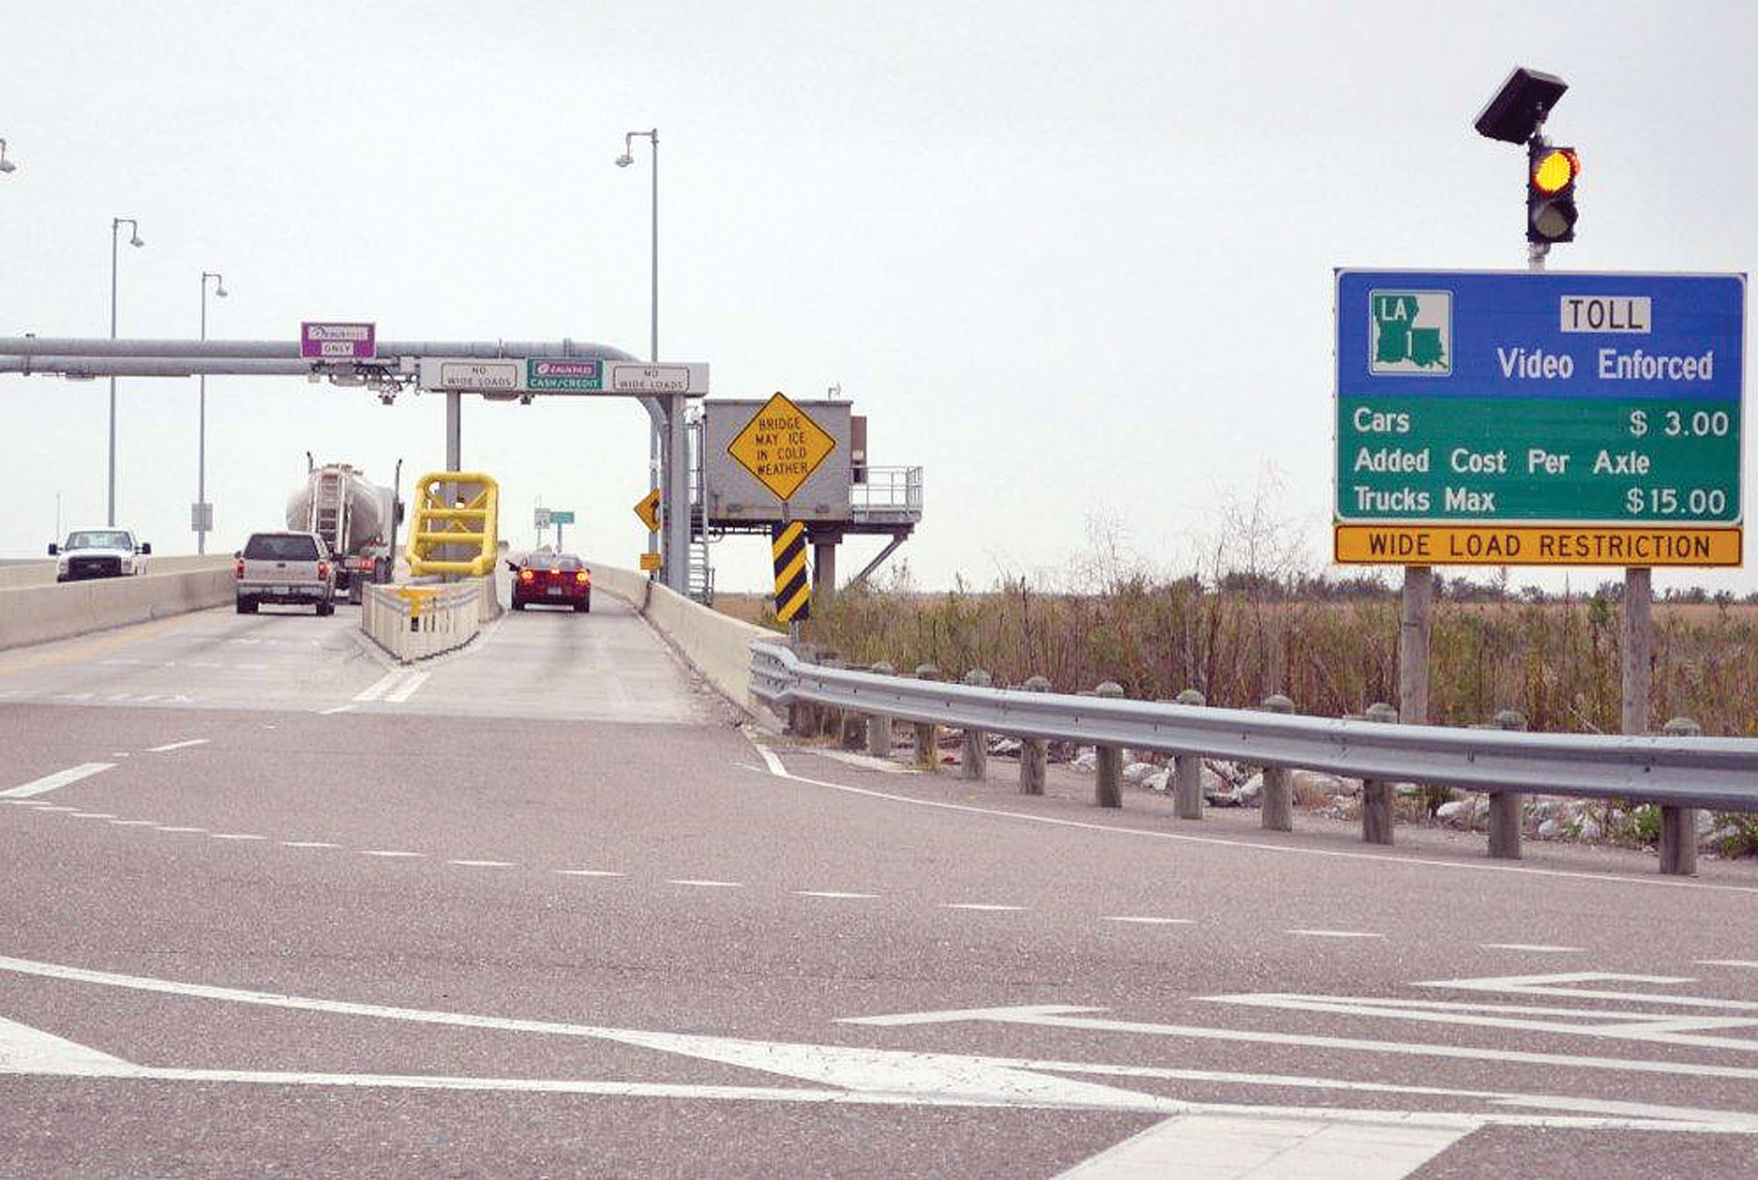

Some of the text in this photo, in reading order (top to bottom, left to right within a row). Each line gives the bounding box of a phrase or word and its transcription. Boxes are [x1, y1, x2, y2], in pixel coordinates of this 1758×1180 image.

[1381, 298, 1408, 321] LA
[1569, 299, 1643, 329] TOLL
[324, 343, 352, 353] ONLY
[1405, 330, 1412, 357] 1
[471, 366, 487, 375] NO
[644, 369, 658, 378] NO
[1497, 348, 1713, 381] Video Enforced
[447, 377, 512, 387] WIDE LOADS
[530, 378, 598, 388] CASH/CREDIT
[619, 380, 684, 390] WIDE LOADS
[758, 418, 802, 431] BRIDGE
[1354, 408, 1410, 433] Cars
[1664, 411, 1729, 436] 3.00
[755, 432, 805, 446] MAY ICE
[757, 448, 807, 460] IN COLD
[1354, 449, 1651, 474] Added Cost Per Axle
[757, 463, 808, 476] WEATHER
[1354, 486, 1496, 511] Trucks Max
[1625, 487, 1726, 515] $15.00
[1369, 534, 1710, 558] WIDE LOAD RESTRICTION
